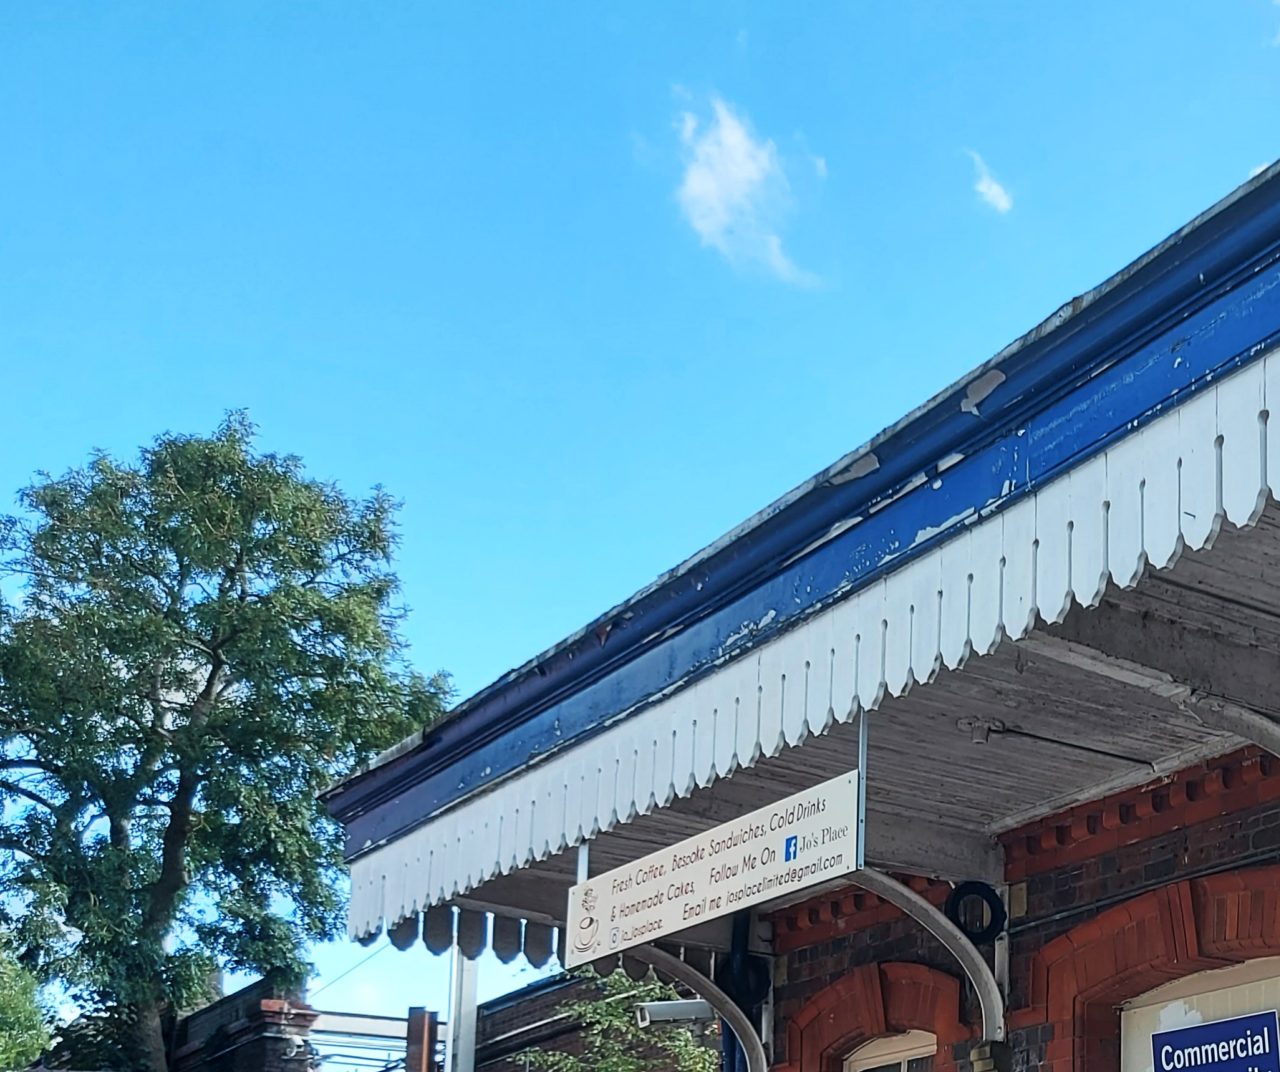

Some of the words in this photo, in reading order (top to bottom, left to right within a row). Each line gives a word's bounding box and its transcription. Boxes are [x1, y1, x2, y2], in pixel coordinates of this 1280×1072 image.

[612, 874, 633, 895] Fresh
[635, 864, 667, 886] Coffee,
[672, 845, 705, 872] Bespoke
[708, 824, 767, 857] Sandwiches,
[769, 806, 796, 831] Cold
[796, 797, 826, 821] Drinks
[799, 831, 819, 853] Jo's
[821, 825, 848, 845] Place
[682, 897, 706, 920] Email
[709, 895, 722, 912] me
[726, 853, 843, 906] josplacelimited@gmail.com
[709, 863, 739, 886] Follow
[741, 853, 757, 874] Me
[760, 847, 776, 866] On
[619, 889, 664, 918] Homemade
[1161, 1026, 1270, 1071] Commercial
